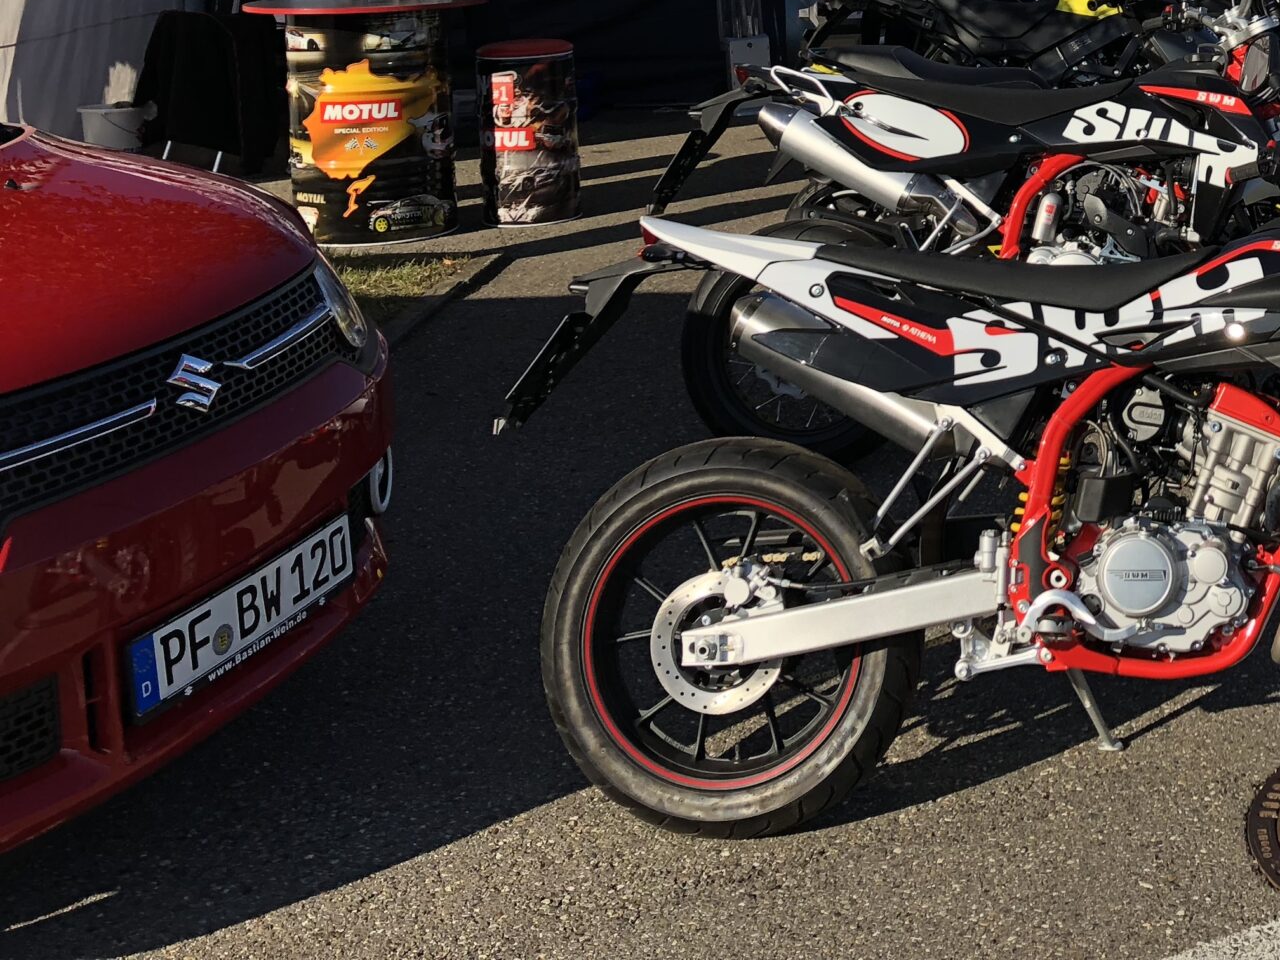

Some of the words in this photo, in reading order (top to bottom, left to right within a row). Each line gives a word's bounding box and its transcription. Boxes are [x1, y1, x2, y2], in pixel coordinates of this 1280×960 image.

[1196, 92, 1236, 107] SWM
[324, 102, 398, 120] MOTUL
[296, 192, 326, 204] MOTUL
[160, 609, 212, 686] PF
[236, 566, 281, 640] BW
[291, 526, 348, 605] 120
[208, 611, 307, 682] www.Bastian-Wein.de
[142, 681, 151, 697] D
